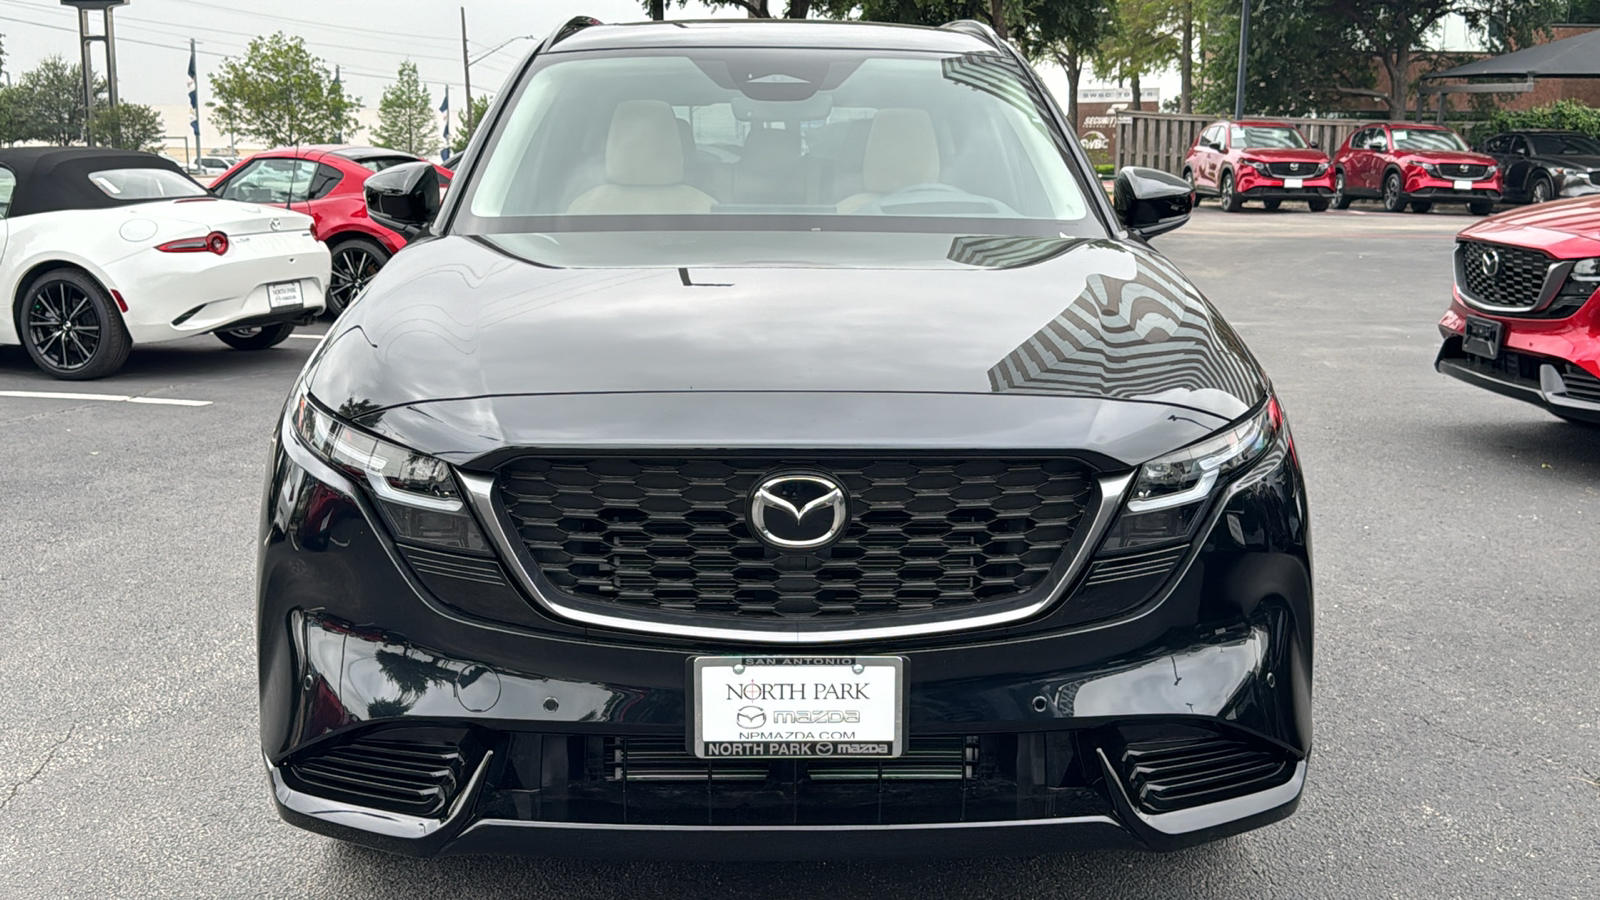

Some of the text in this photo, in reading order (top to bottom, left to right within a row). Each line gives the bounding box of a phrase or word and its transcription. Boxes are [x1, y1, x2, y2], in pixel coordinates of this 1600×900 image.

[725, 682, 871, 701] NORTH PARK
[773, 710, 861, 724] mazda
[739, 731, 856, 740] NPMAZDACOM
[708, 743, 888, 756] NORTH PARK mazda
